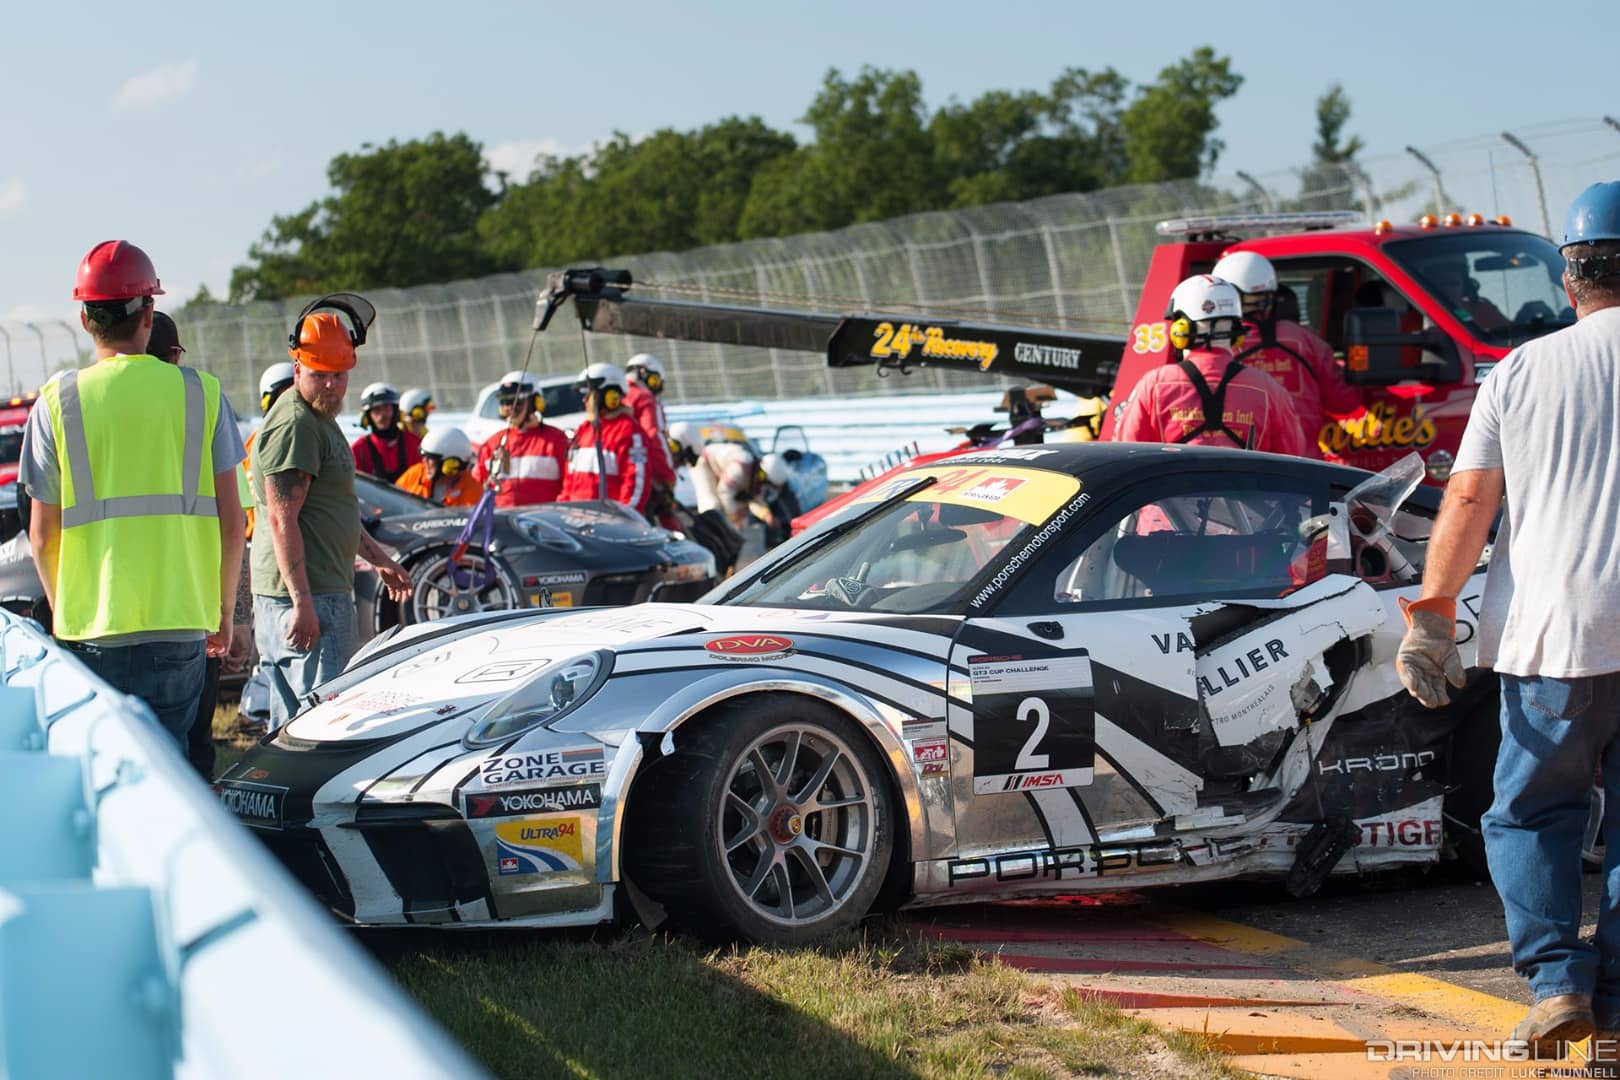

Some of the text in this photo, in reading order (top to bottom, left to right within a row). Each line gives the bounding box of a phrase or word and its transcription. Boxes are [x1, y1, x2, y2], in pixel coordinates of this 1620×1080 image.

[921, 326, 999, 371] Recovery
[1133, 322, 1168, 354] 35
[1014, 342, 1082, 369] CENTURY
[1169, 407, 1206, 421] Watkin
[1318, 402, 1437, 453] arlie's
[969, 491, 1091, 610] www.porschemotorsport.com
[539, 572, 585, 586] YOKOHAMA
[715, 638, 785, 650] DVA
[1005, 665, 1049, 674] CHALLENGE
[1014, 697, 1050, 770] 2
[483, 752, 560, 773] ZONE
[484, 761, 605, 784] GARAGE
[1022, 774, 1064, 788] IMSA
[500, 789, 595, 812] YOKOHAMA
